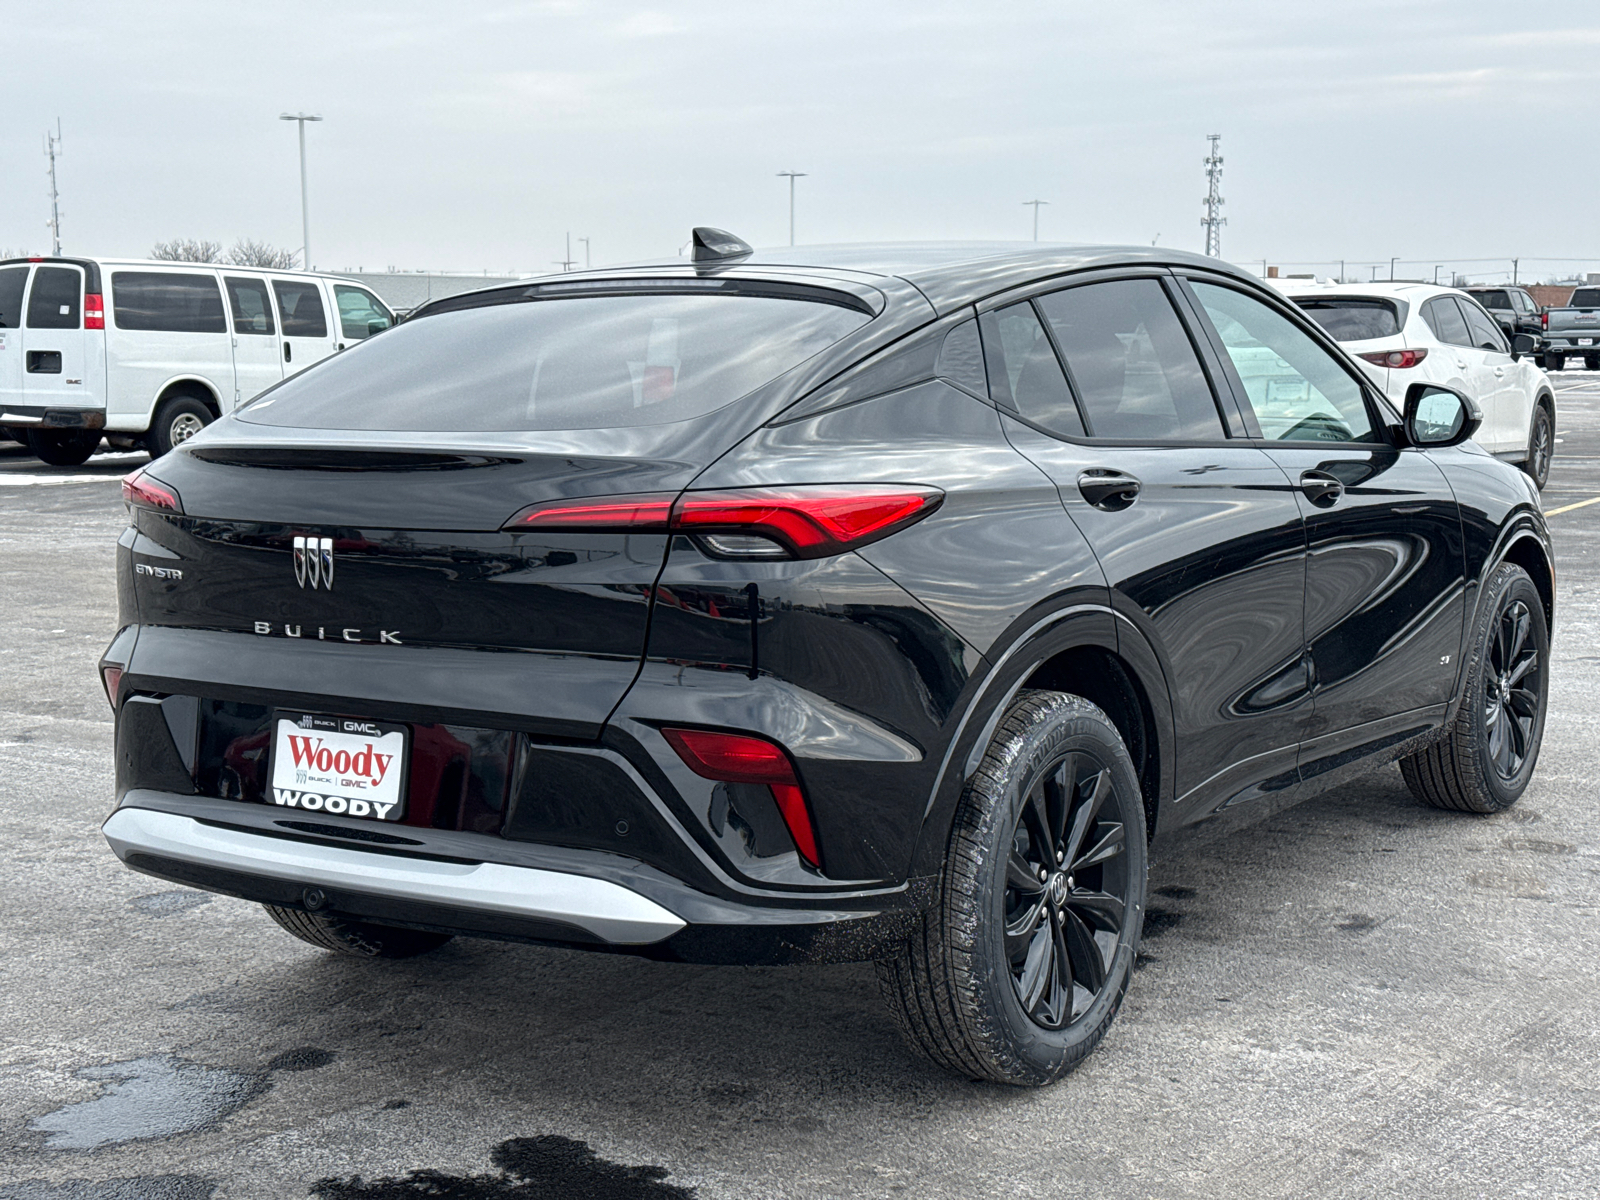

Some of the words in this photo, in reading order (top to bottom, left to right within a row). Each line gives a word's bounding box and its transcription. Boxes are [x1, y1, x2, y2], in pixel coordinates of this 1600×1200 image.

[254, 621, 402, 644] BUICK
[344, 721, 376, 734] GMC
[287, 735, 394, 787] Woody
[341, 778, 367, 789] GMC
[273, 788, 394, 820] WOODY
